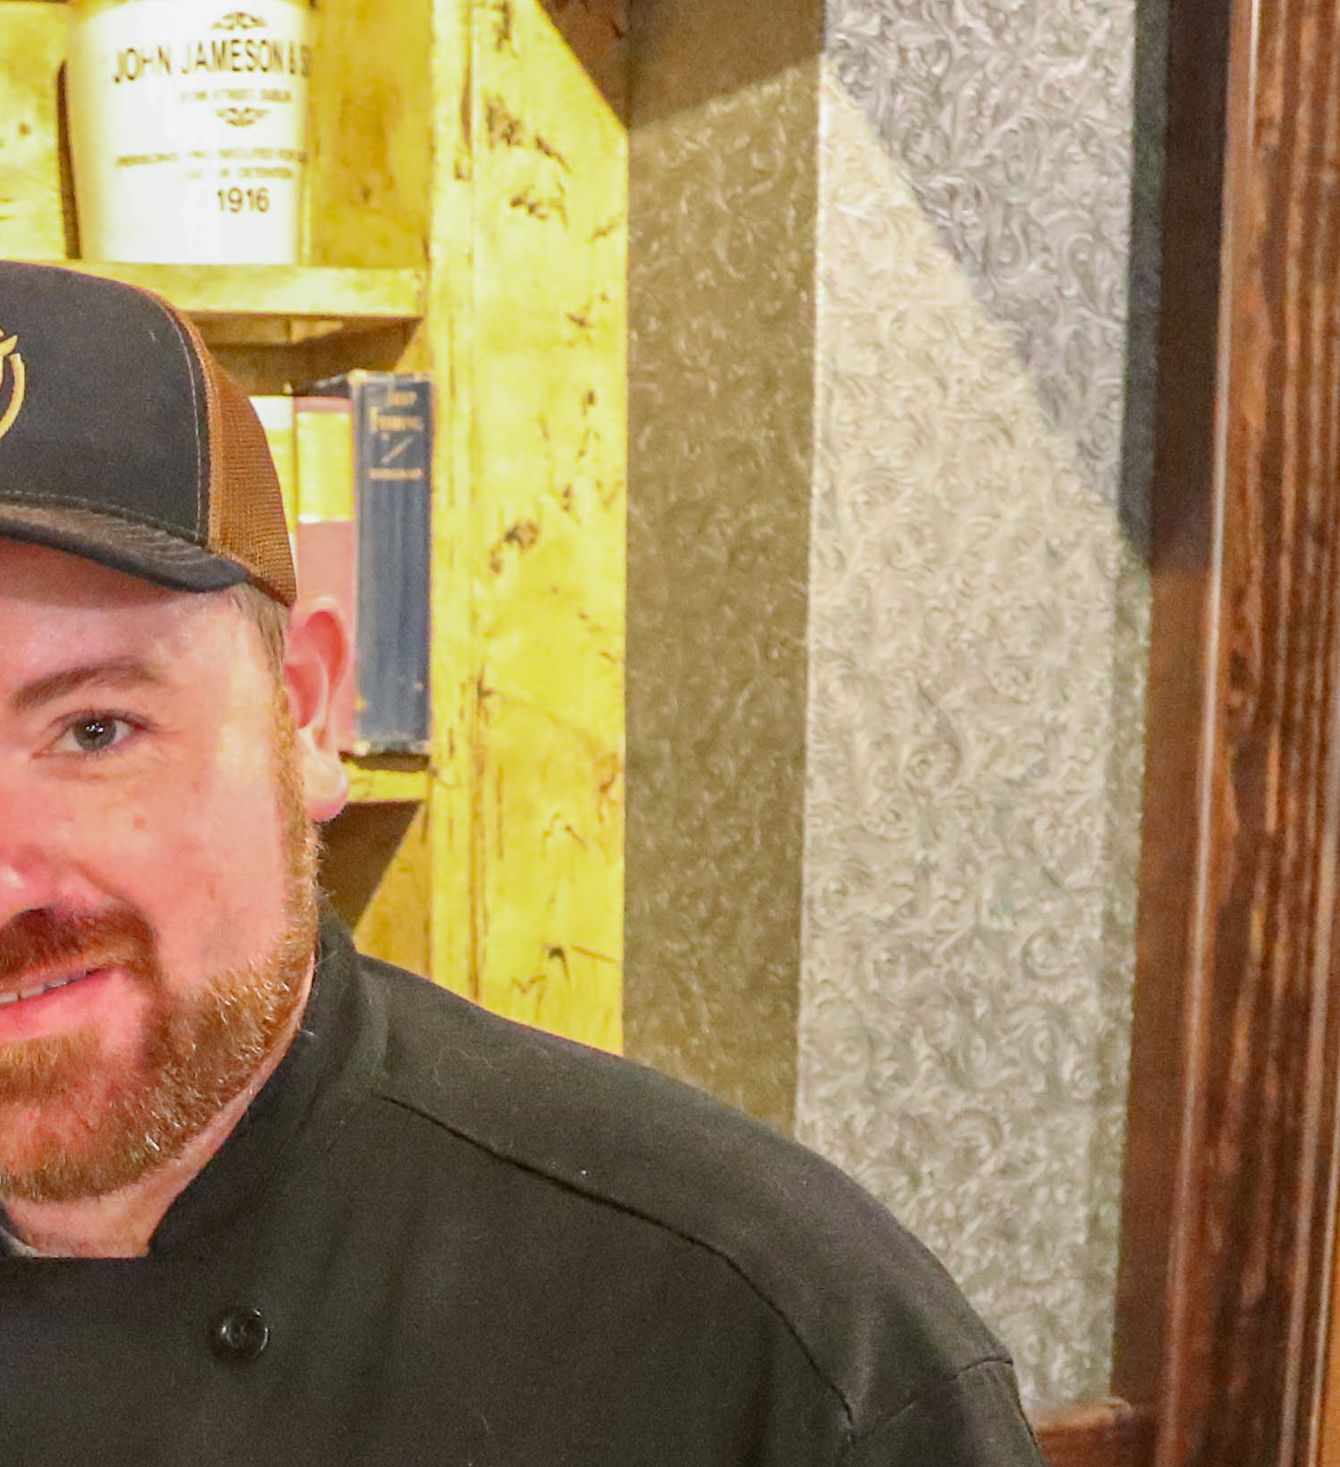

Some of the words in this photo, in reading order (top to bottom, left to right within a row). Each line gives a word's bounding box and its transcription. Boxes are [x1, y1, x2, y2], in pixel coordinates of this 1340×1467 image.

[114, 45, 172, 84] JOHN
[180, 38, 284, 75] JAMESON
[216, 186, 270, 213] 1916
